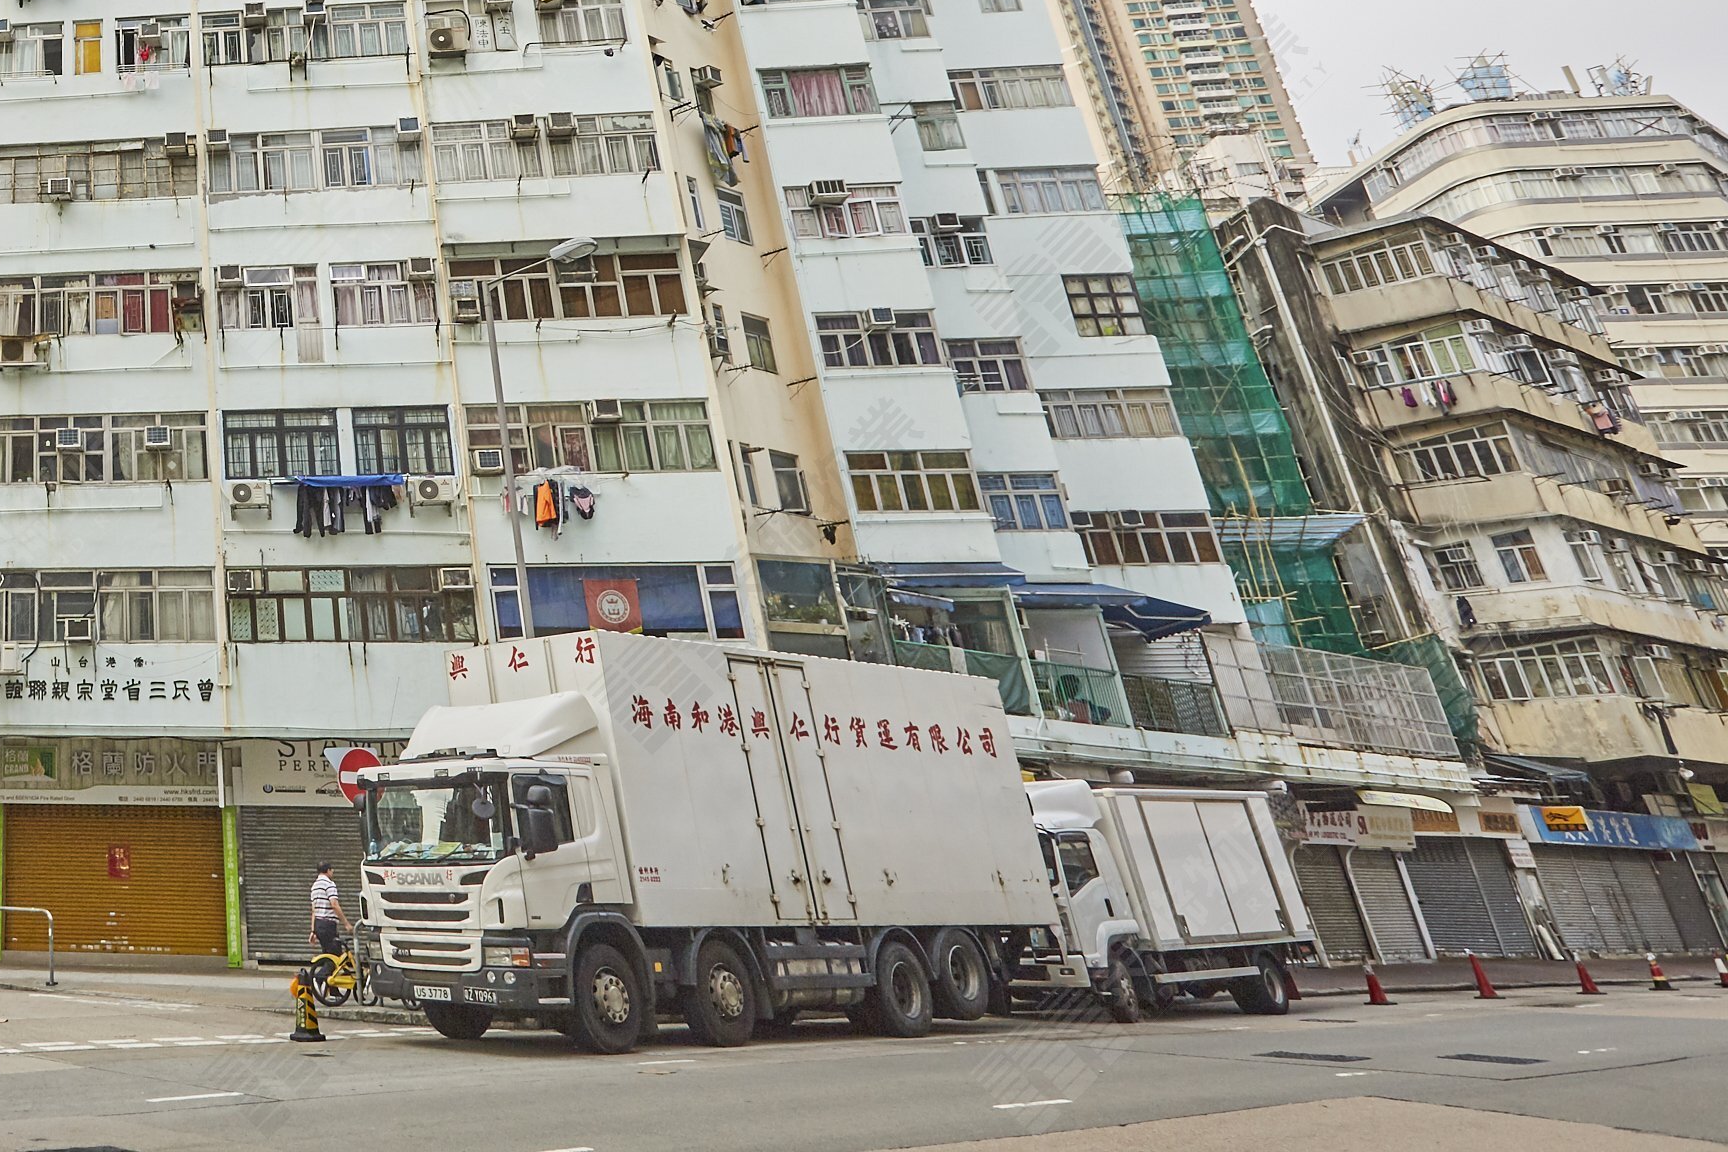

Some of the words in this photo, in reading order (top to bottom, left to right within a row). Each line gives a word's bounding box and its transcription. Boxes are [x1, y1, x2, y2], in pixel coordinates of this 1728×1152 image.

[71, 751, 218, 777] 格蘭防火門
[397, 872, 445, 885] SCANIA
[416, 986, 427, 997] US
[428, 987, 449, 999] 3778
